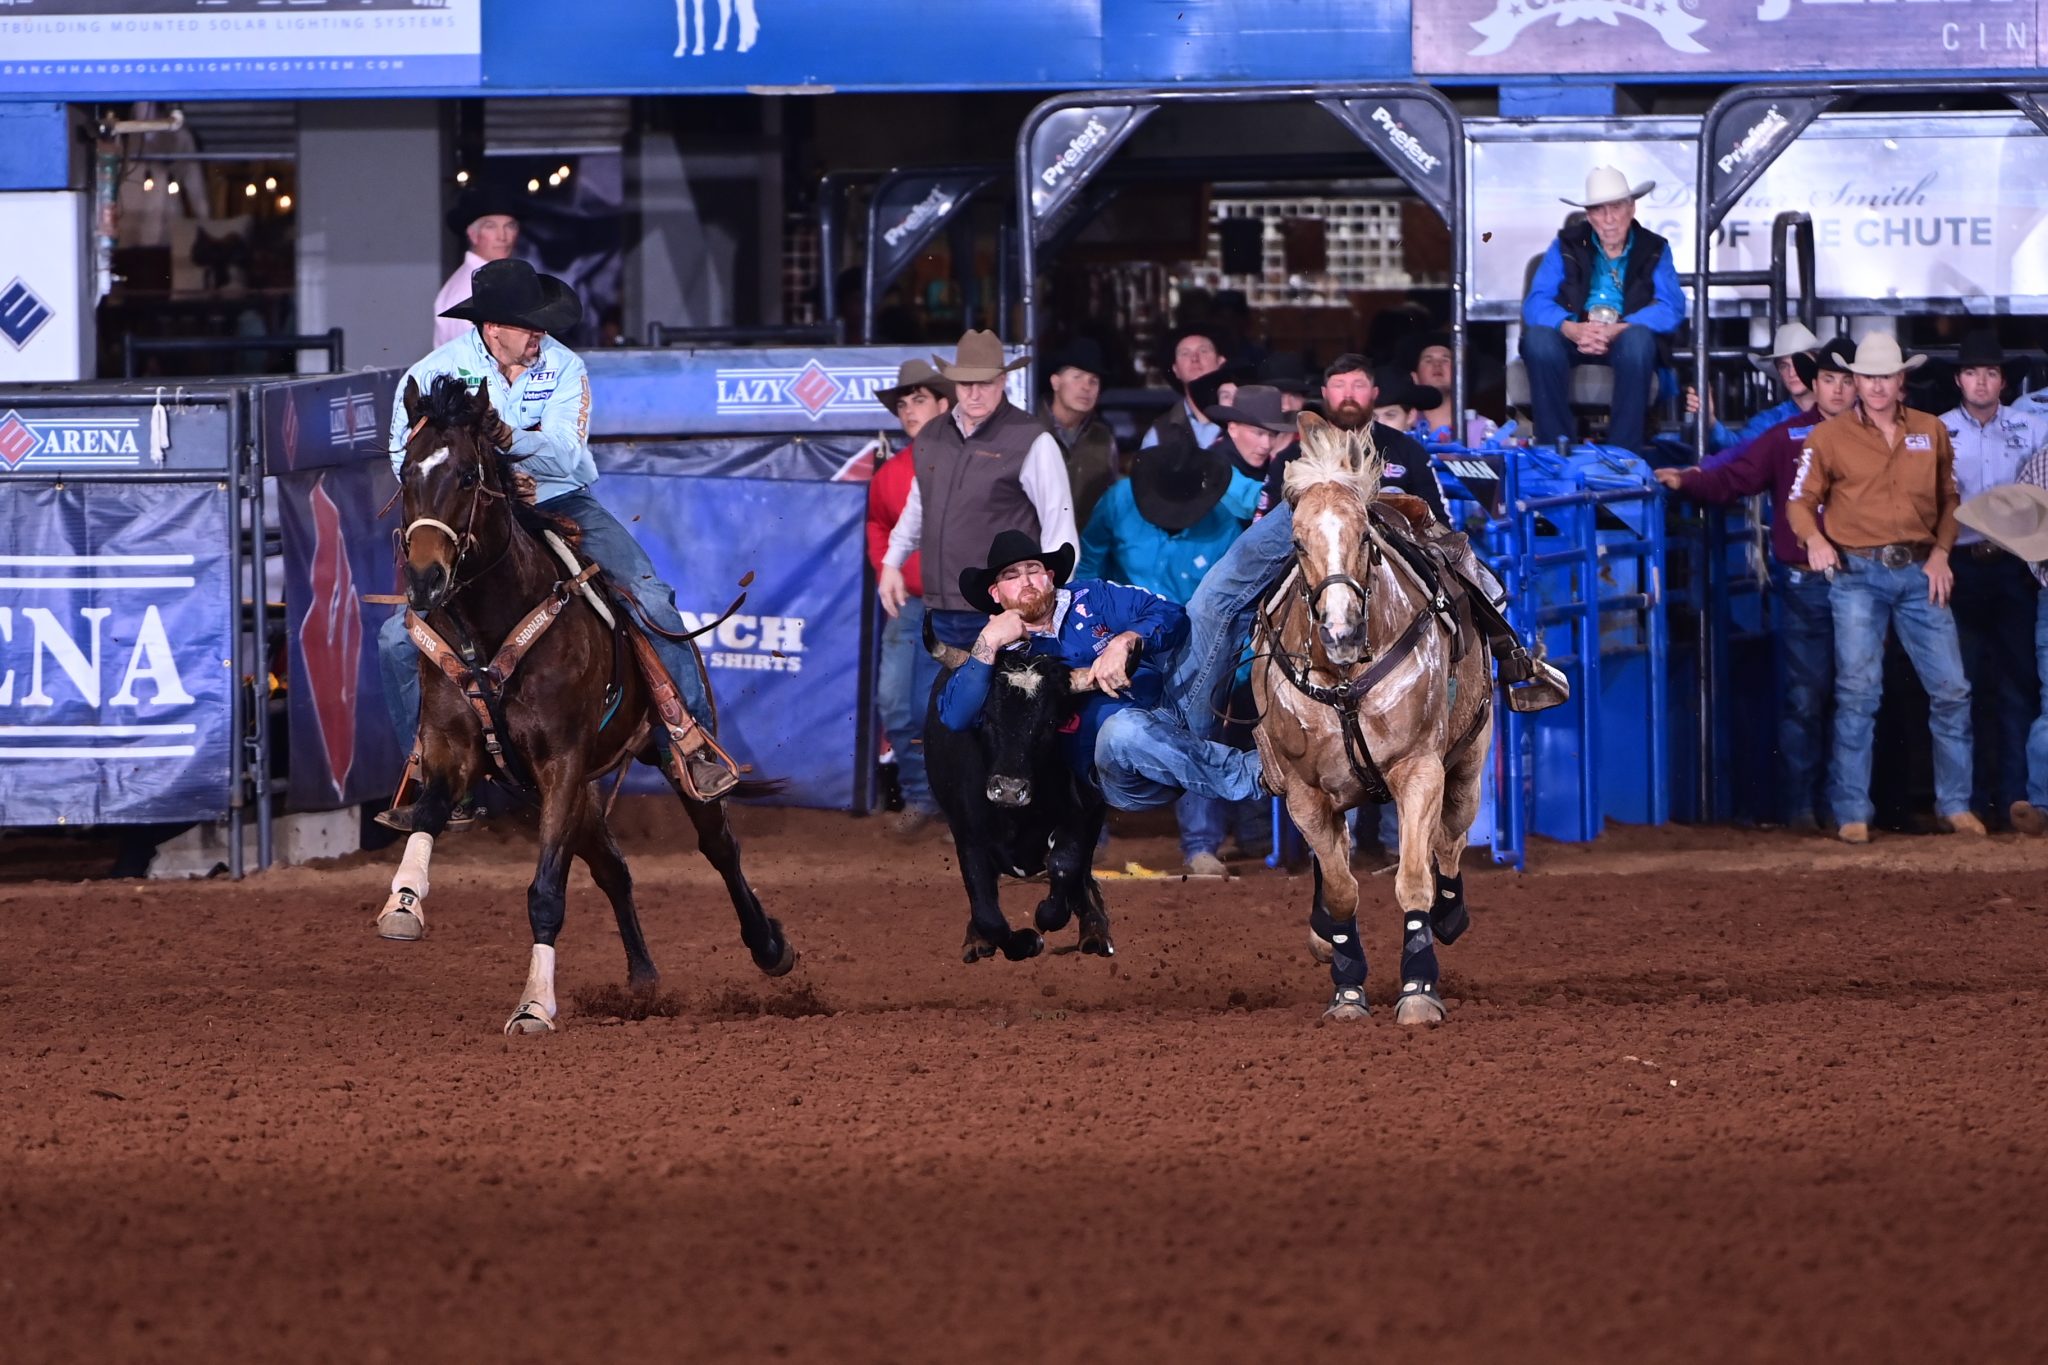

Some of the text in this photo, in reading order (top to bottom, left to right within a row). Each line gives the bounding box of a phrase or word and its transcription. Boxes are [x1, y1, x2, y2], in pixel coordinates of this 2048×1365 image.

[111, 19, 198, 32] MOUNTED
[210, 18, 267, 31] SOLAR
[276, 17, 364, 30] LIGHTING
[374, 16, 455, 28] SYSTEMS
[1371, 106, 1437, 170] Priefert
[1042, 120, 1107, 186] Priefert
[1809, 170, 1938, 208] Smith
[1854, 216, 1992, 247] CHUTE
[530, 371, 555, 381] YETI
[716, 380, 787, 403] LAZY
[42, 428, 139, 455] ARENA
[1443, 460, 1500, 480] MAN
[413, 624, 437, 652] CACTUS
[711, 652, 802, 672] SHIRTS
